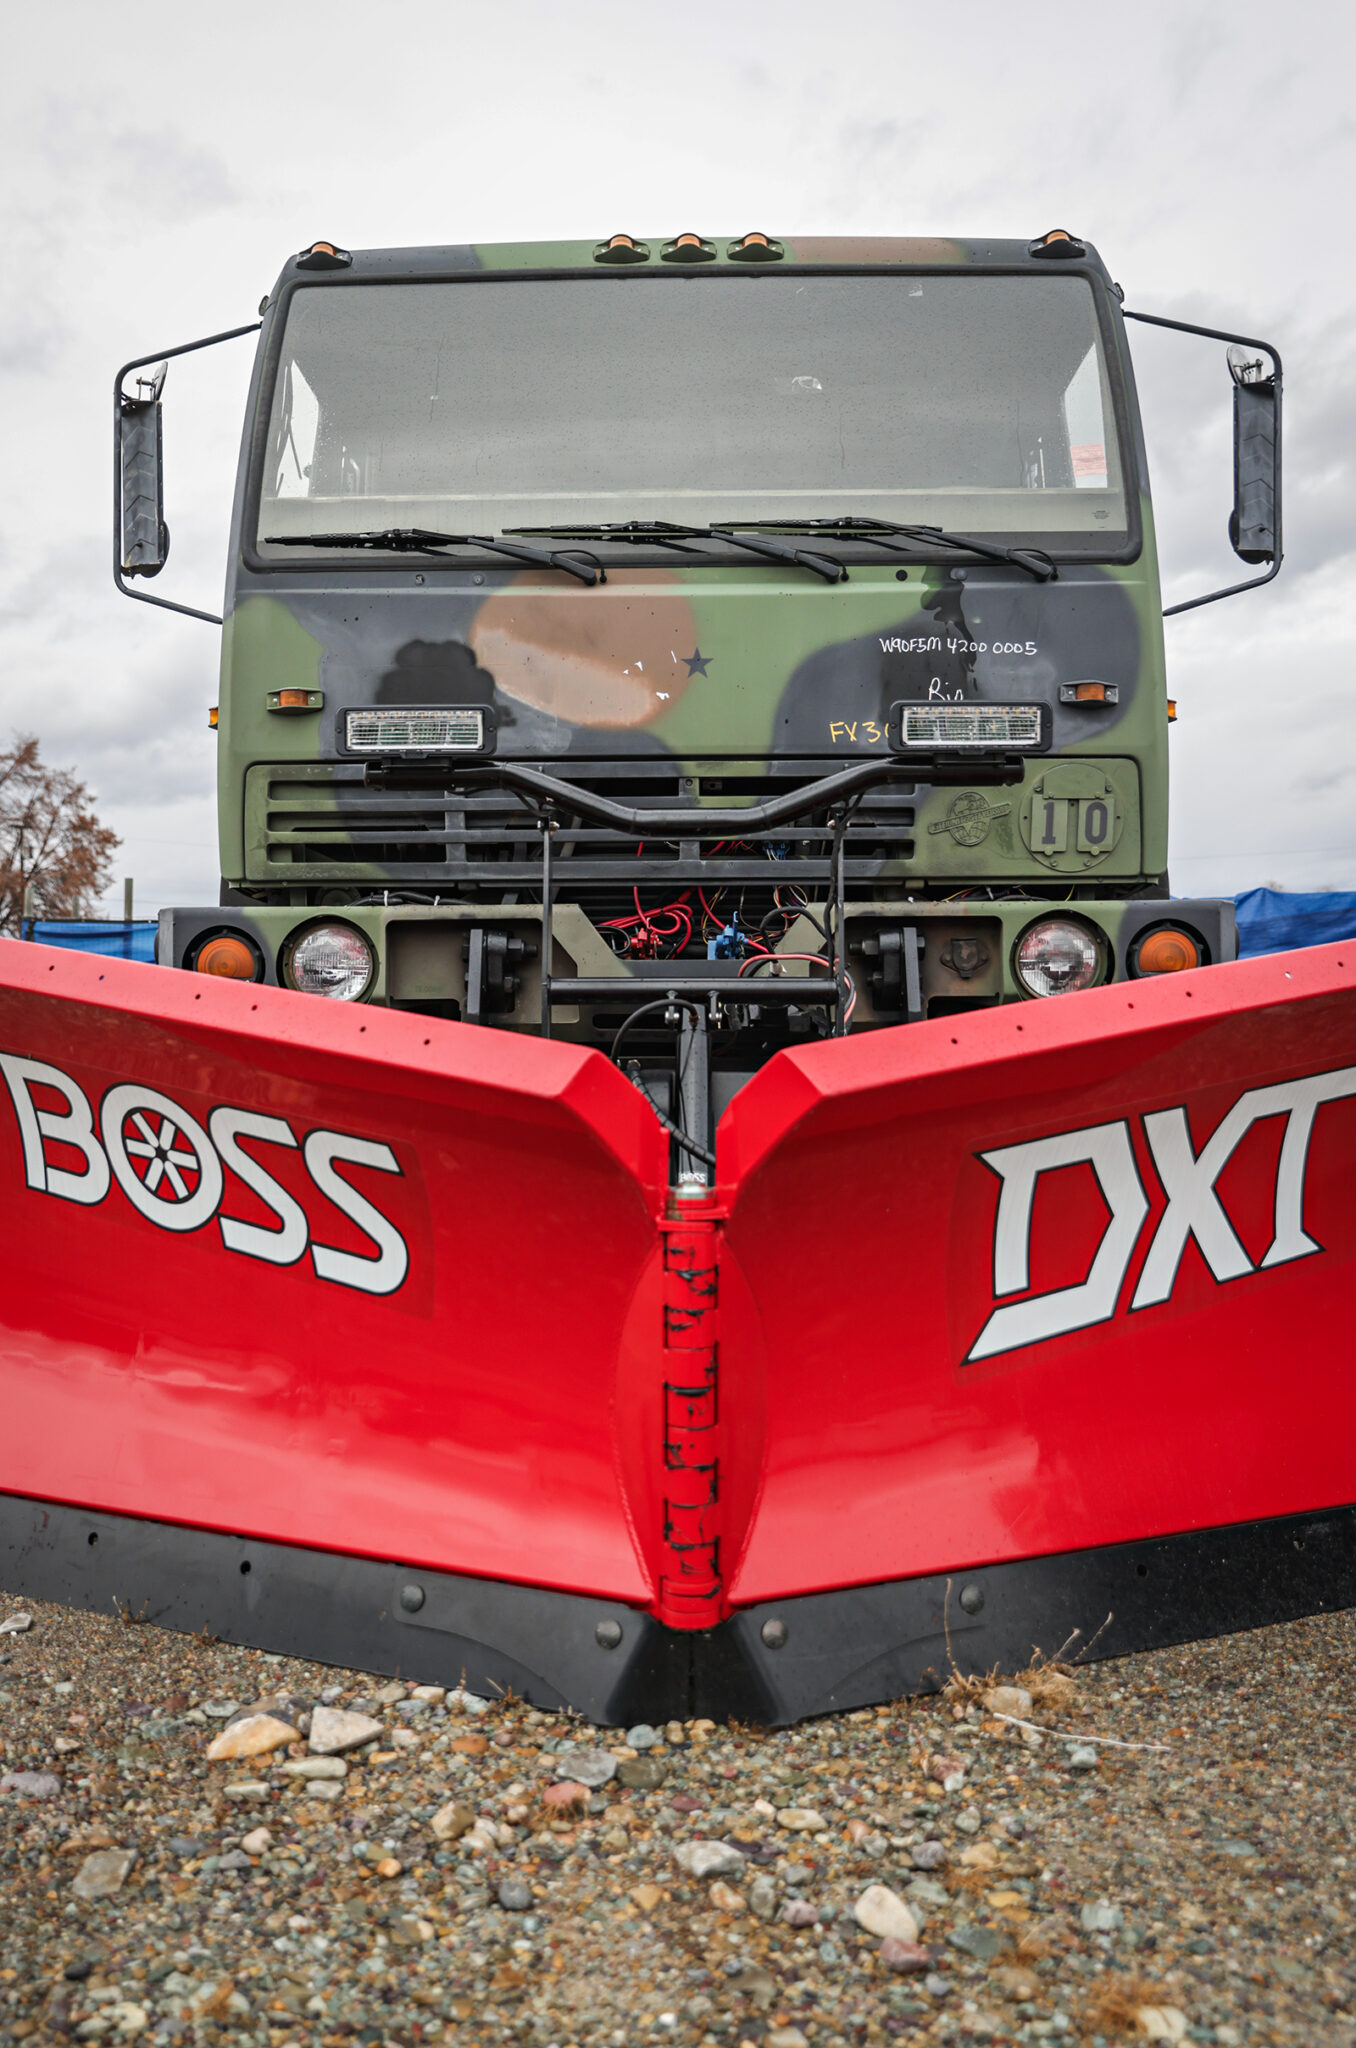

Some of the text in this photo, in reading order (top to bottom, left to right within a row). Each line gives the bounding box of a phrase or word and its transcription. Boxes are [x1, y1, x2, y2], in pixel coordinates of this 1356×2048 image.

[947, 638, 987, 655] 4200
[992, 641, 1038, 656] 0005
[0, 1051, 410, 1296] BOSS
[959, 1065, 1356, 1367] DXT
